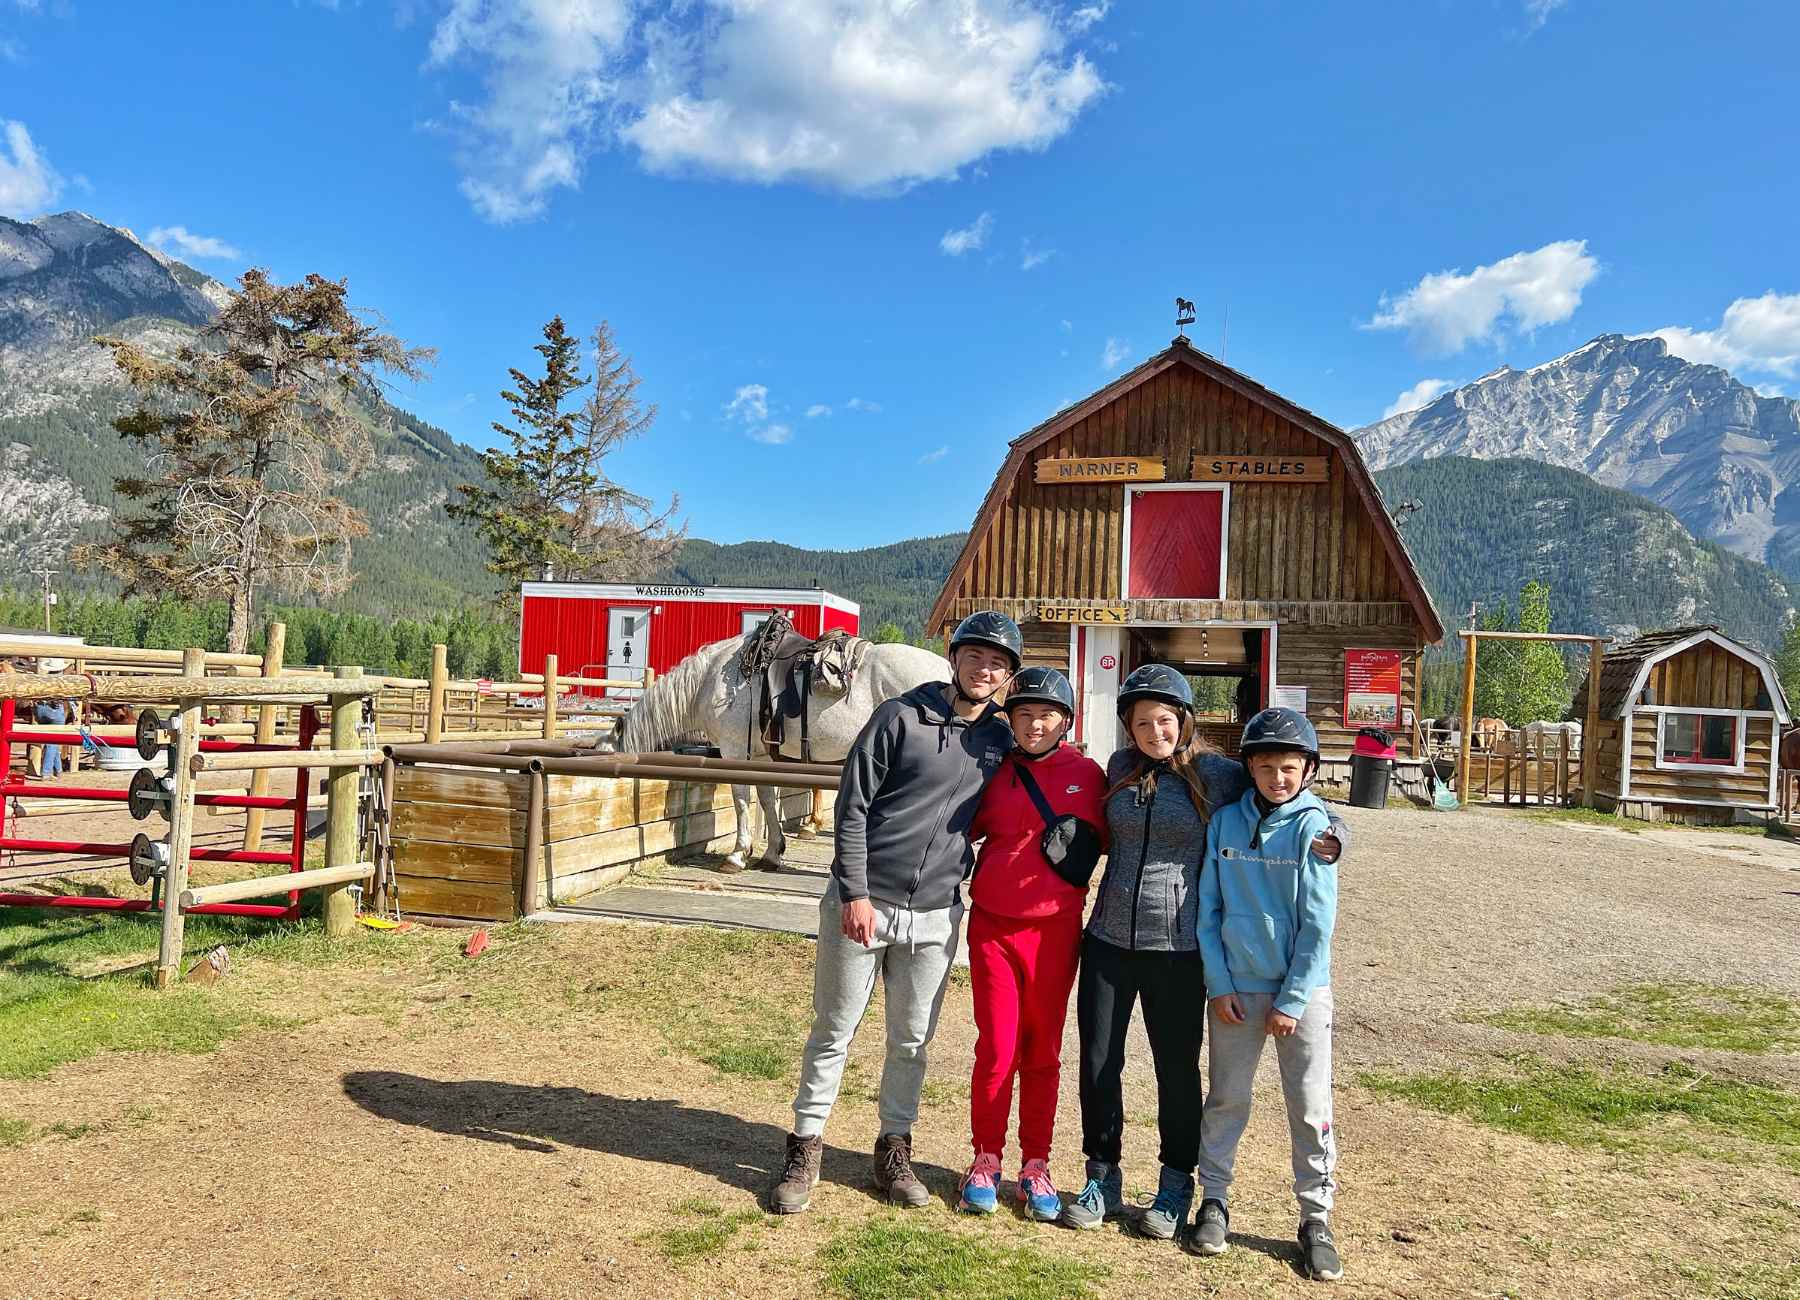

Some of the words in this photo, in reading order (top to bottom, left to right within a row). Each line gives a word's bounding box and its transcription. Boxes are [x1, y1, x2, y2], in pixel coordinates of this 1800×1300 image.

[1059, 461, 1139, 476] WARNER
[1211, 461, 1305, 475] STABLES
[635, 586, 705, 597] WASHROOMS
[1045, 607, 1104, 621] OFFICE
